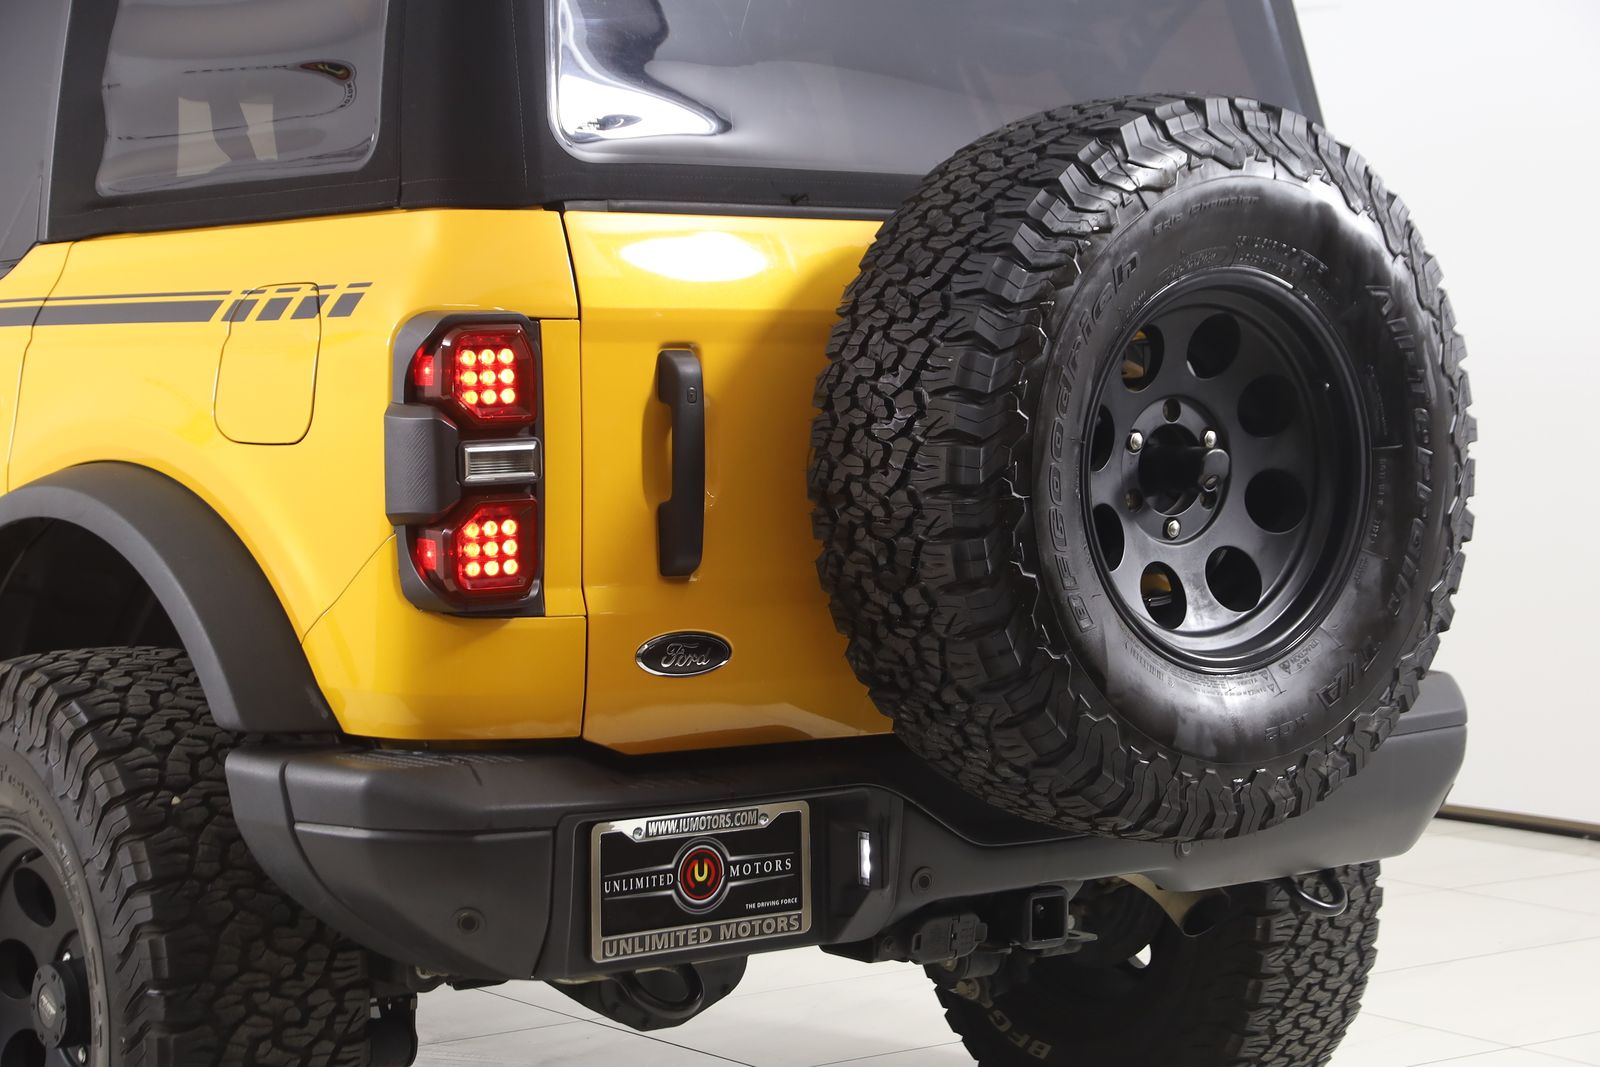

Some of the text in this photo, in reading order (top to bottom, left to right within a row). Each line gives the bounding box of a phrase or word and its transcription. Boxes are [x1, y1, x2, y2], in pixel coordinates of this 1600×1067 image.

[660, 642, 712, 668] Ford
[647, 809, 758, 836] WWW.IUMOTORS.COM
[729, 858, 793, 877] MOTORS
[604, 873, 674, 894] UNLIMITED
[757, 899, 780, 908] DRIVING
[780, 897, 798, 905] FORCE
[604, 915, 800, 957] UNLIMITED MOTORS
